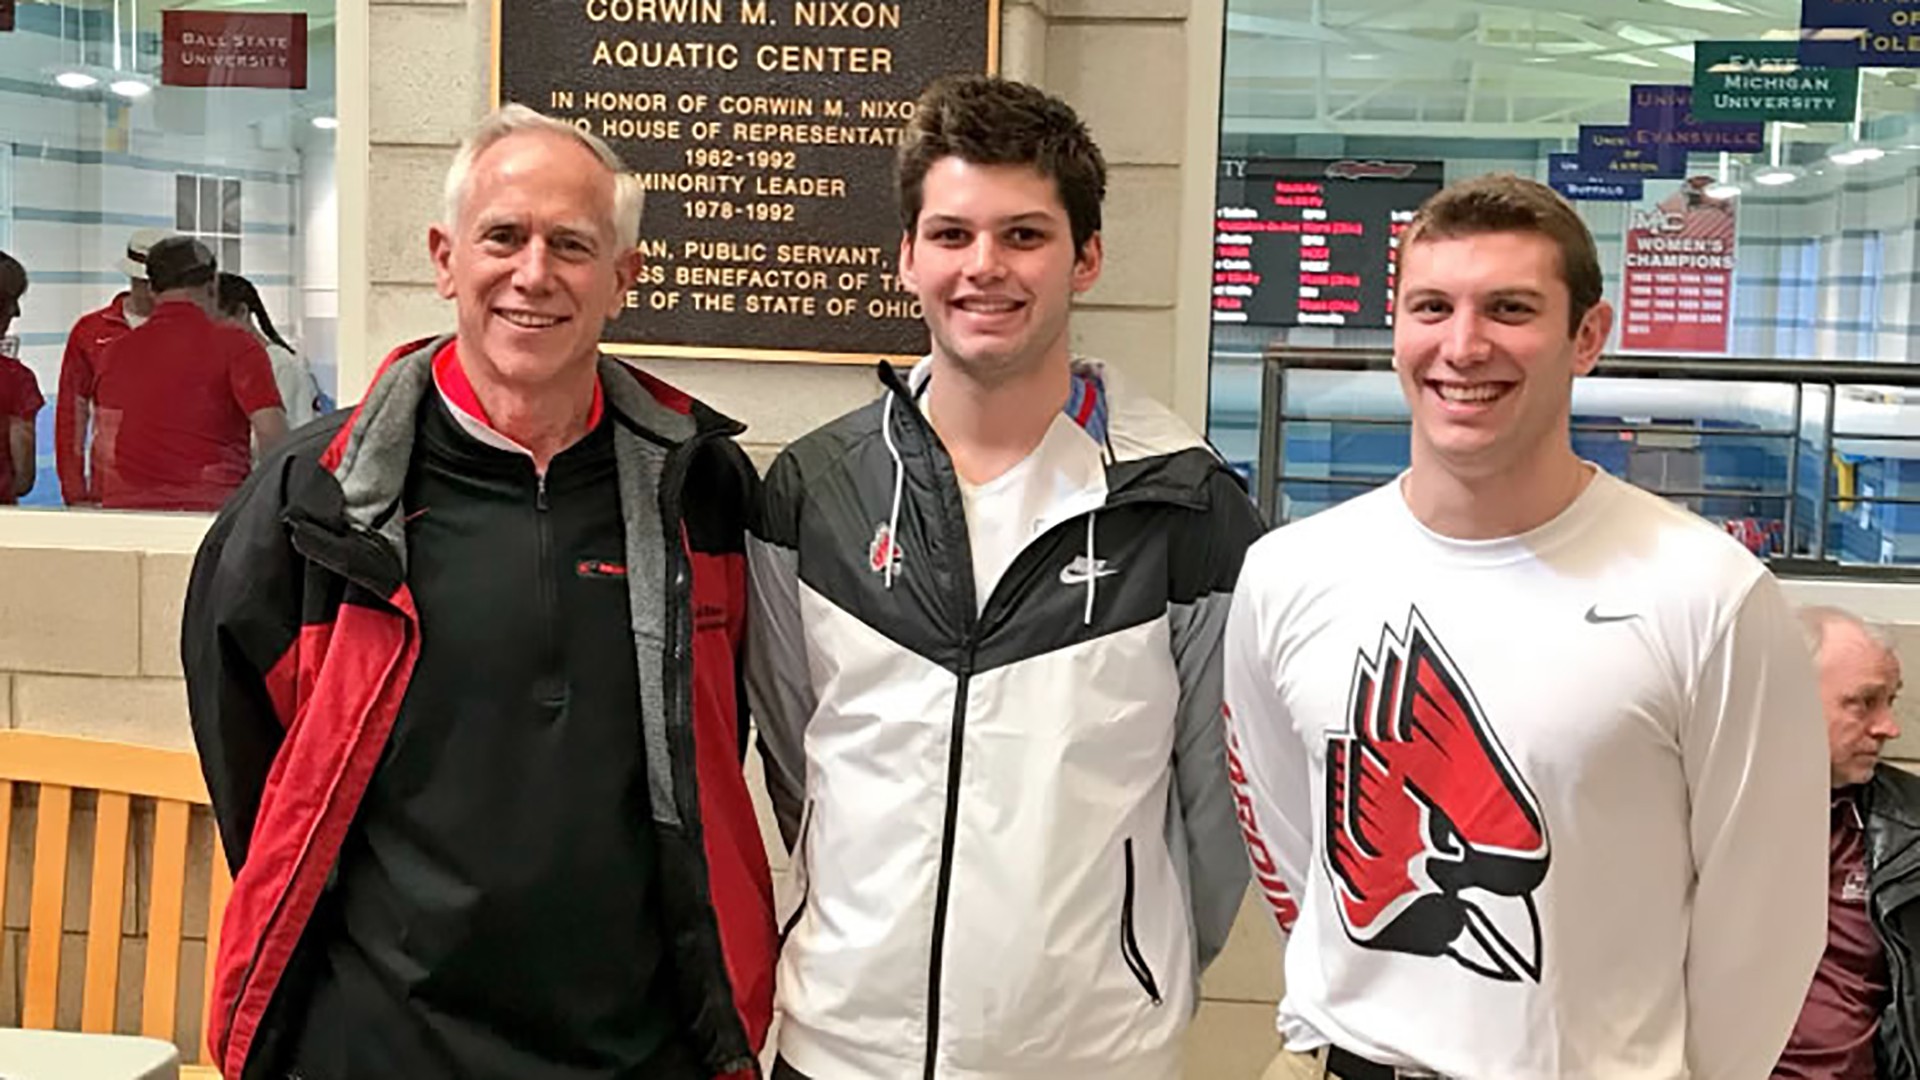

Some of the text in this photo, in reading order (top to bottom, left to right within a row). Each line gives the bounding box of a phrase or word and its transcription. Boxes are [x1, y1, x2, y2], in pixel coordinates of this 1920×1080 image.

[586, 0, 901, 28] CORWIN M. NIXON
[182, 32, 288, 49] BALL STATE
[181, 52, 288, 68] UNIVERSITY
[592, 41, 892, 73] AQUATIC CENTER
[1724, 75, 1829, 90] MICHIGAN
[551, 92, 573, 108] IN
[584, 92, 667, 112] HONOR
[678, 94, 708, 113] OF
[719, 96, 812, 116] CORWIN
[824, 98, 850, 118] M.
[1714, 94, 1836, 109] UNIVERSITY
[603, 119, 681, 139] HOUSE
[692, 121, 721, 140] OF
[1637, 130, 1760, 145] EVANSVILLE
[685, 148, 796, 170] 1962-1992
[635, 173, 846, 198] MINORITY LEADER
[684, 200, 795, 221] 1978-1992
[685, 241, 767, 262] PUBLIC
[777, 244, 887, 268] SERVANT,
[1626, 253, 1733, 269] CHAMPIONS
[676, 266, 828, 290] BENEFACTOR
[839, 272, 870, 291] OF
[650, 291, 680, 309] OF
[691, 292, 736, 311] THE
[745, 294, 816, 315] STATE
[826, 297, 858, 316] OF
